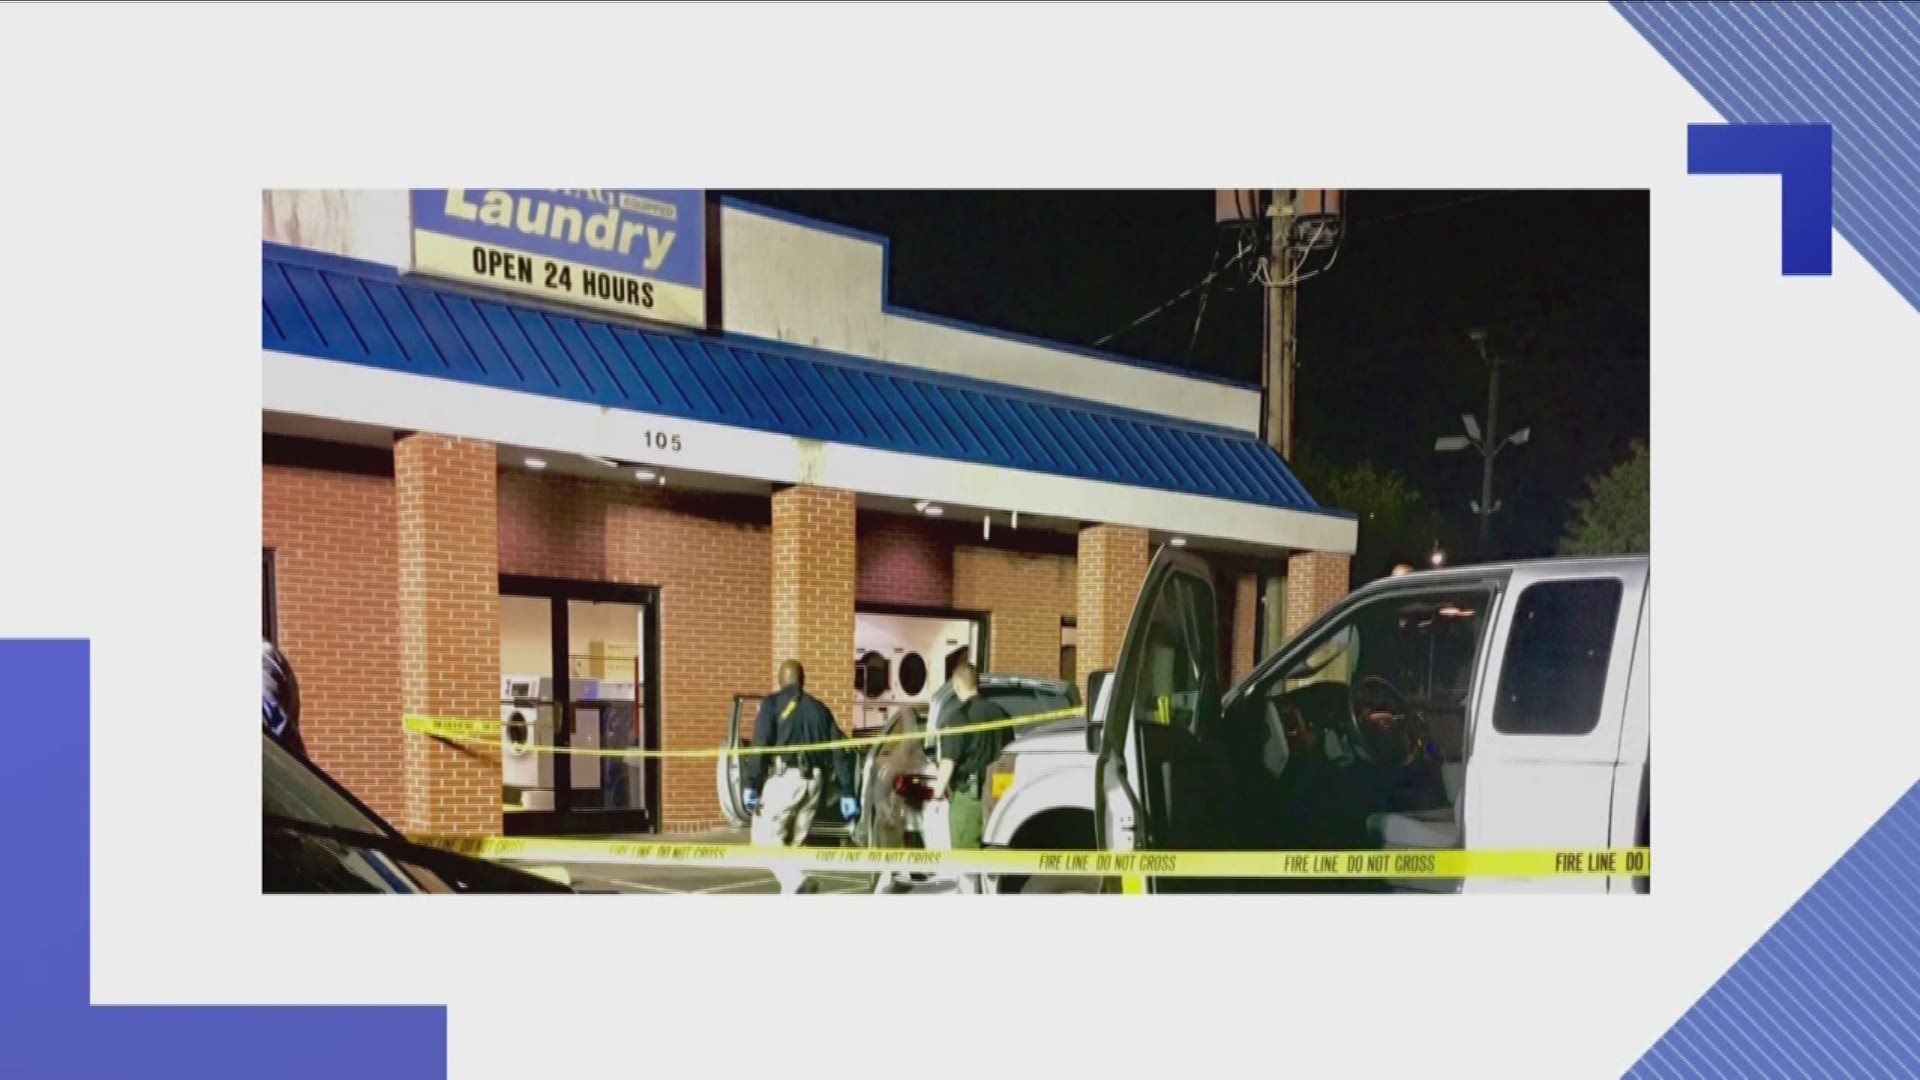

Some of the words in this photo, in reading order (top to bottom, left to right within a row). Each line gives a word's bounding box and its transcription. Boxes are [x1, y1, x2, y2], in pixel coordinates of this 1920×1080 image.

[445, 189, 676, 270] Laundry
[472, 246, 532, 284] OPEN
[544, 262, 572, 292] 24
[583, 269, 654, 308] HOURS
[644, 430, 682, 452] 105
[1039, 853, 1062, 871] FIRE
[1065, 854, 1090, 871] LINE
[1096, 853, 1112, 871] DO
[1114, 854, 1137, 871] NOT
[1138, 854, 1177, 872] CROSS
[1284, 855, 1309, 873] FIRE
[1313, 855, 1339, 873] LINE
[1347, 854, 1364, 873] DO
[1366, 854, 1391, 873] NOT
[1394, 853, 1436, 873] CROSS
[1555, 852, 1584, 873] FIRE
[1587, 852, 1617, 873] LINE
[1625, 851, 1644, 872] DO
